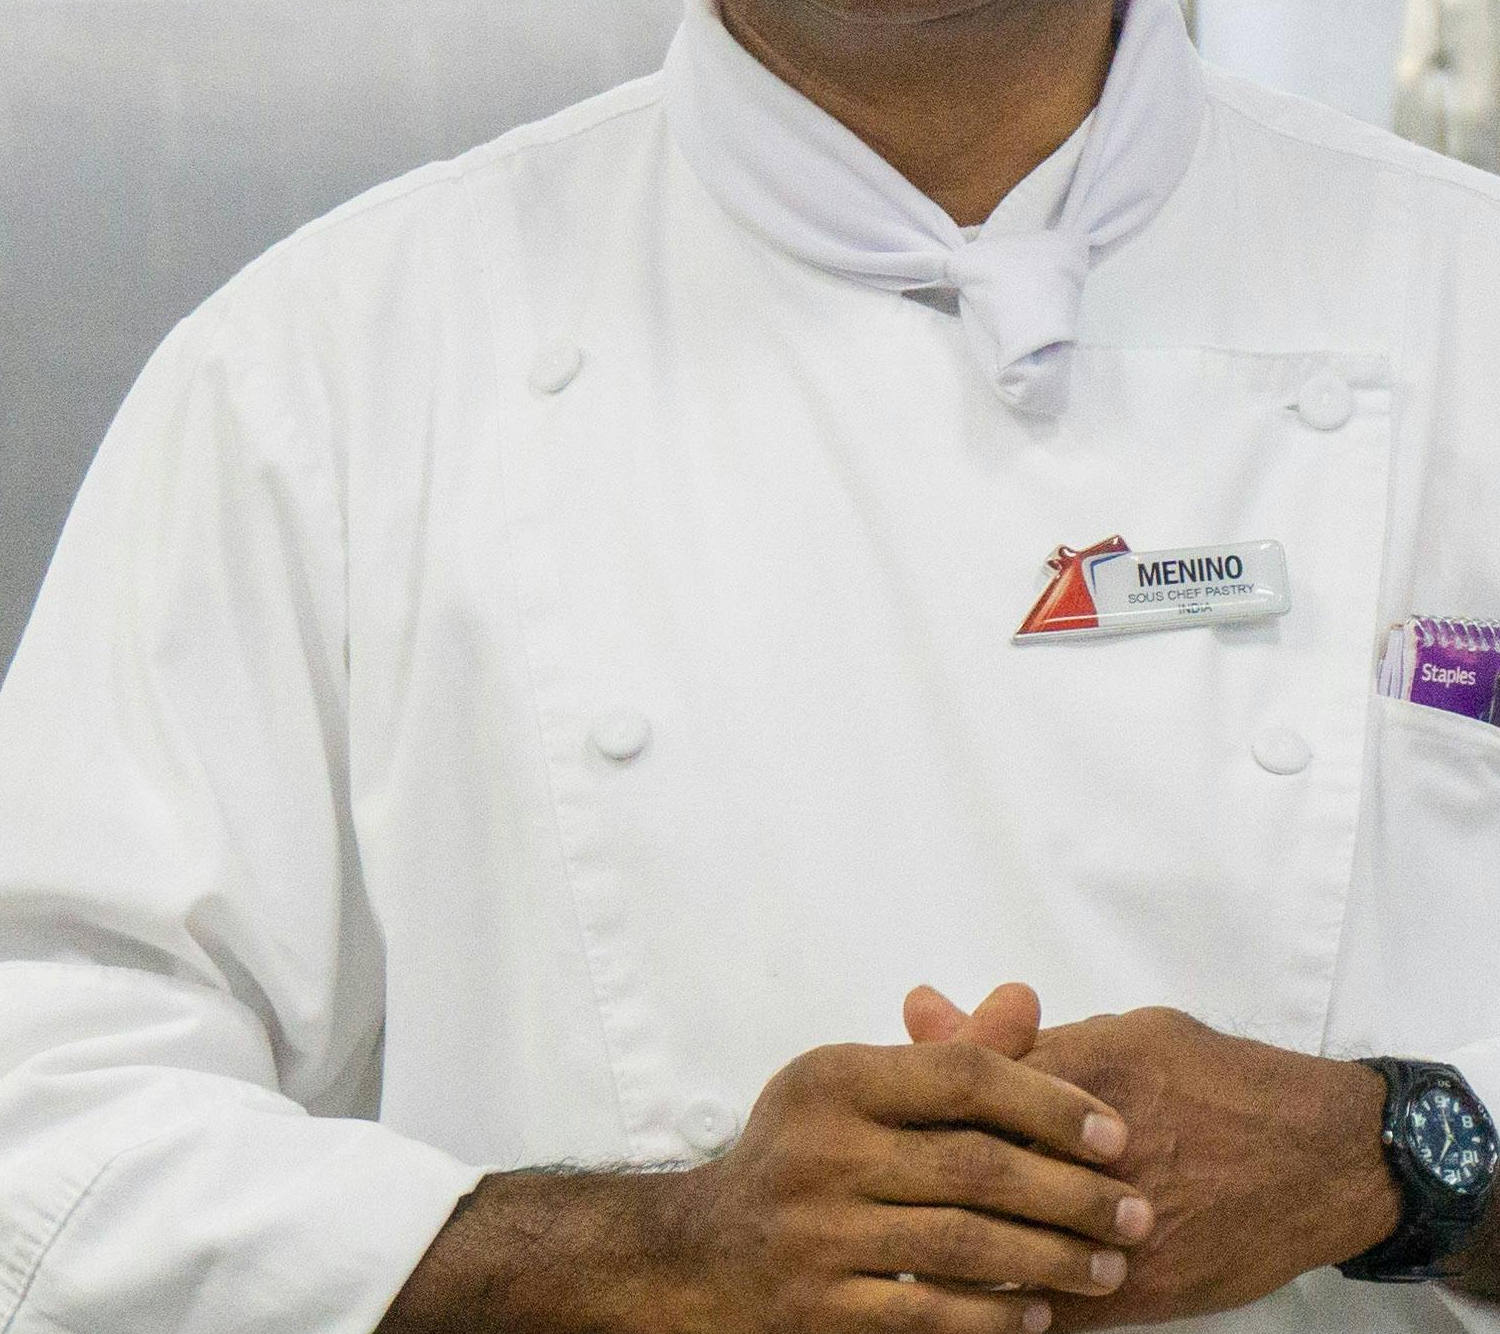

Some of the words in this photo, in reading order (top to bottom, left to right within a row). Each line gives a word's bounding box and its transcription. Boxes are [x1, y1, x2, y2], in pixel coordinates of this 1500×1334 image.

[1138, 555, 1243, 587] MENINO
[1128, 590, 1164, 604] SOUS
[1168, 587, 1202, 601] CHEF
[1205, 583, 1255, 597] PASTRY
[1178, 603, 1212, 615] INDIA
[1422, 663, 1477, 689] Staples
